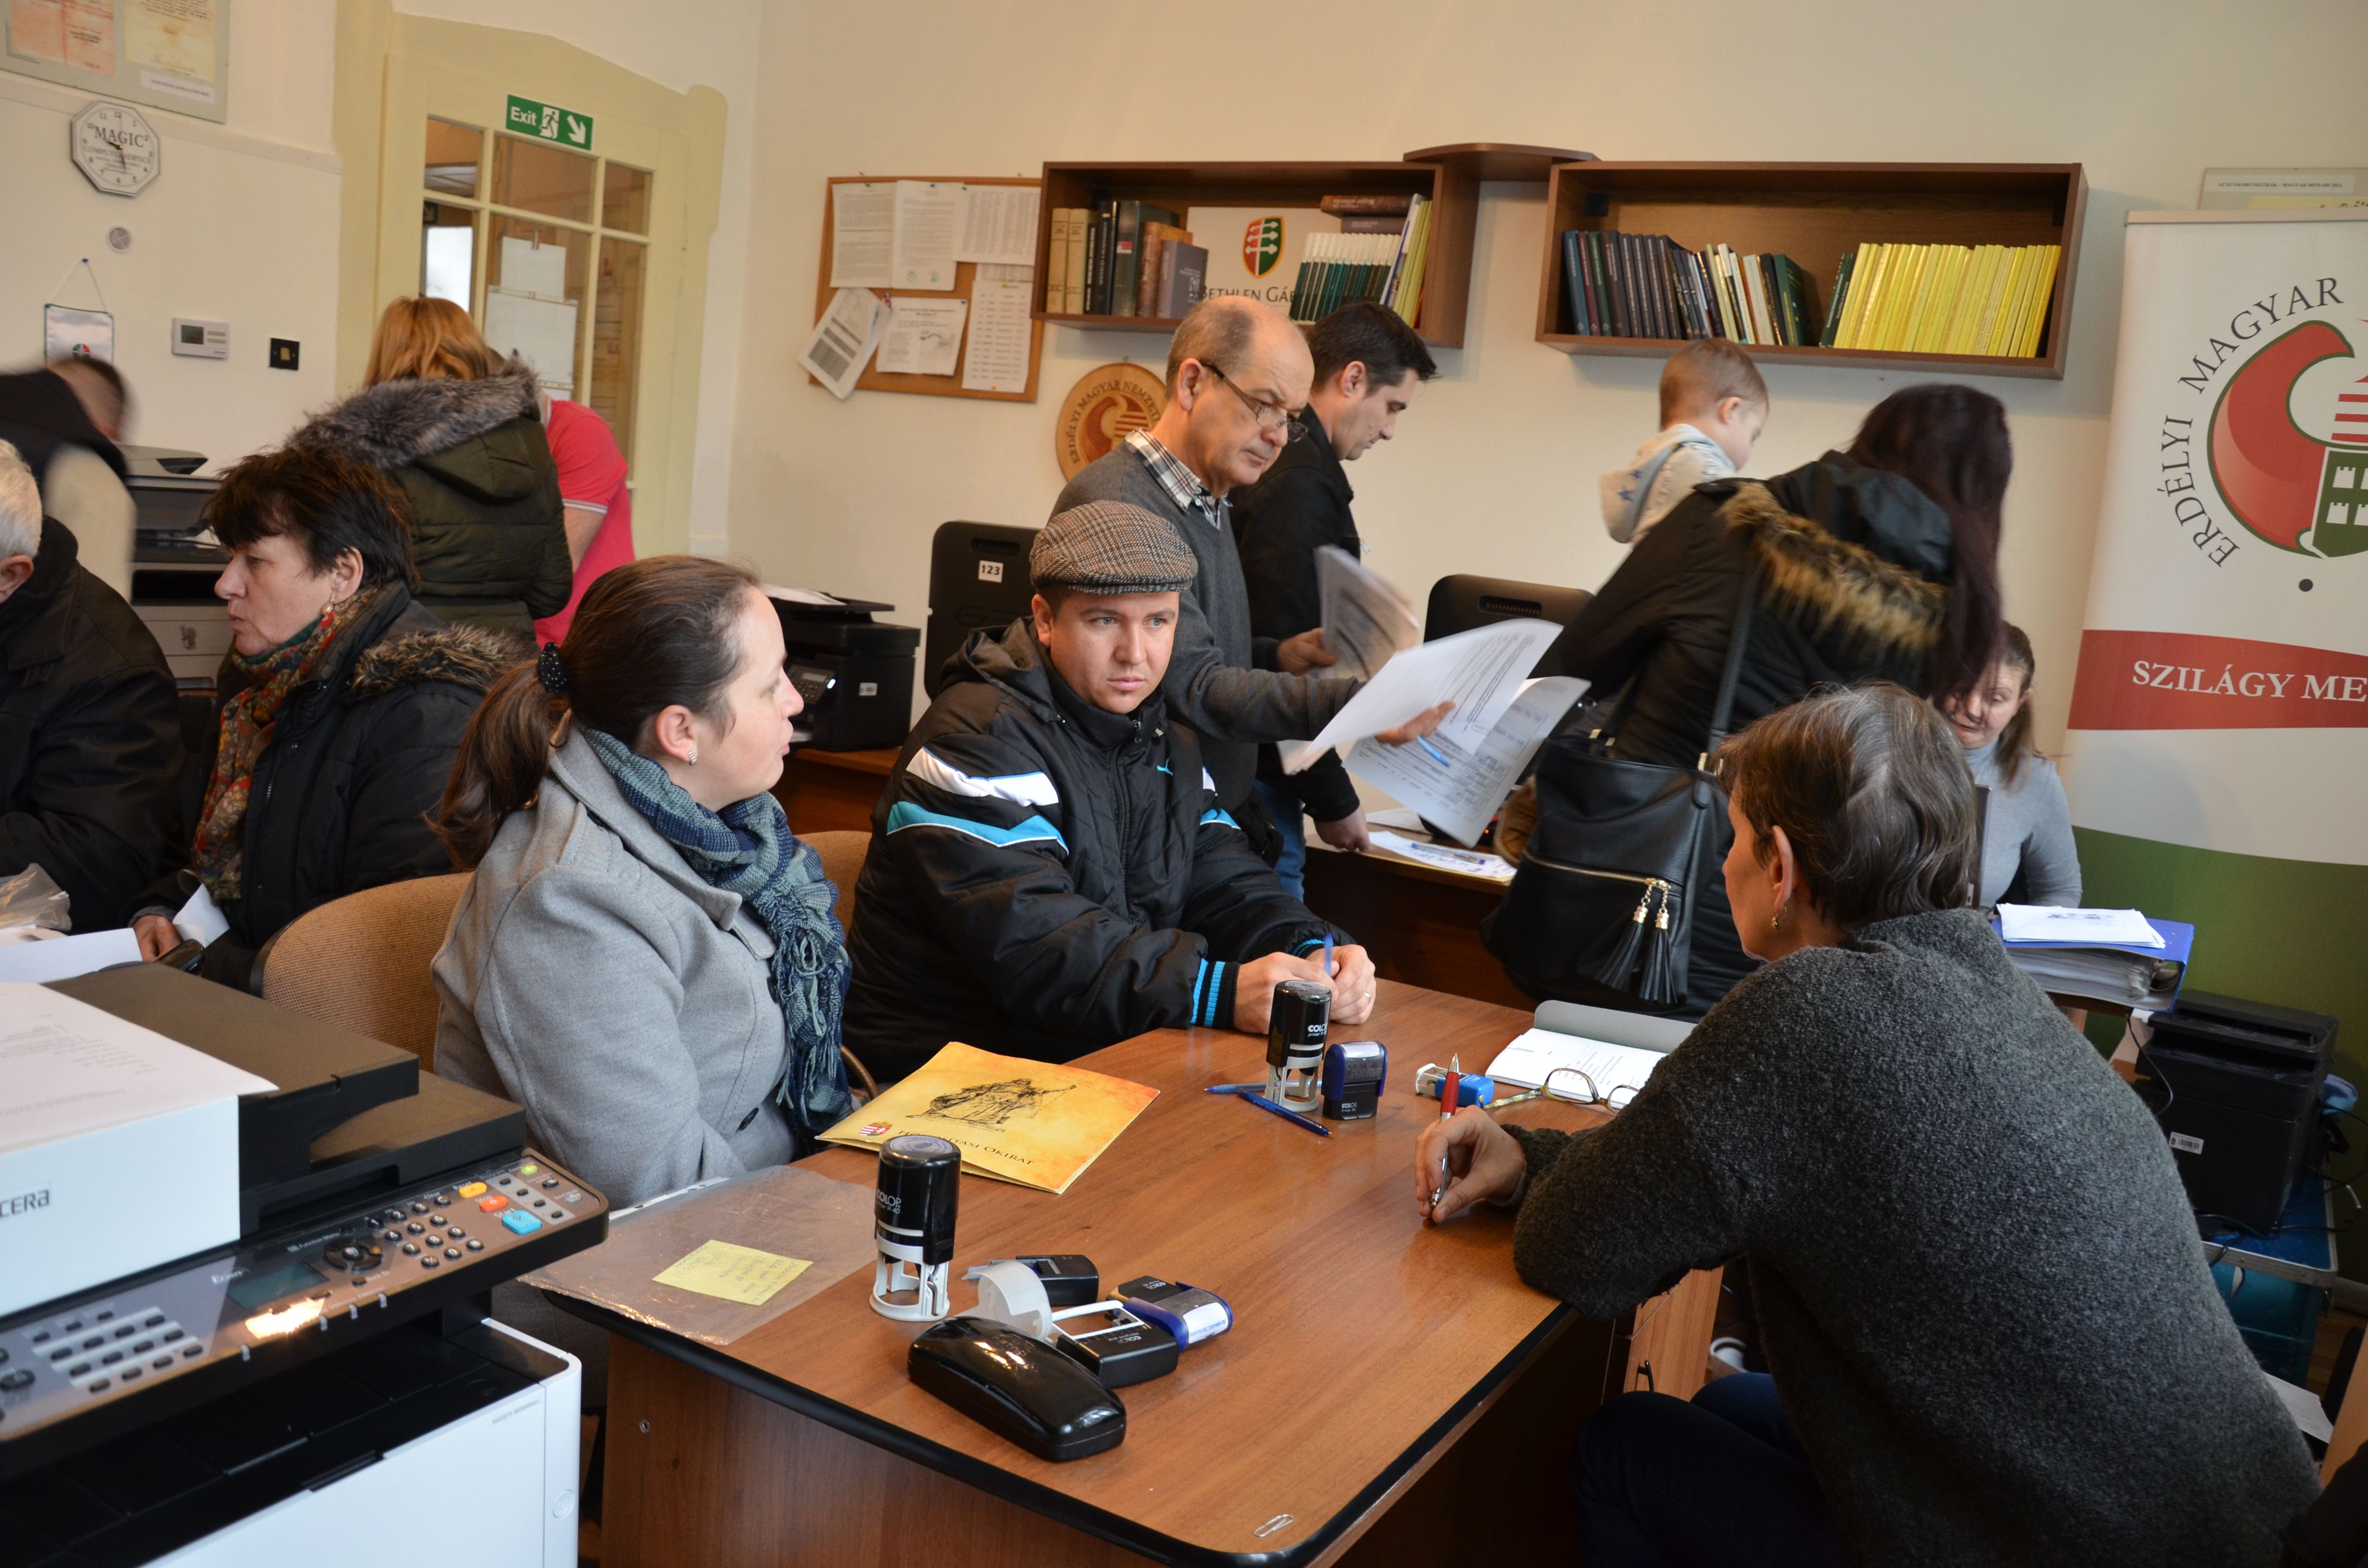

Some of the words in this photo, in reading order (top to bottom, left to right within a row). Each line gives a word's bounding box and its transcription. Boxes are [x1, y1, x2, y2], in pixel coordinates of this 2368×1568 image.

[511, 106, 537, 126] Exit
[94, 125, 144, 148] MAGIC
[2177, 277, 2344, 394] MAGYAR
[1079, 380, 1120, 410] MAGYAR
[2157, 414, 2240, 567] ERDÉLYI
[982, 564, 1000, 576] 123
[2133, 660, 2295, 698] SZILÁGY
[984, 1146, 1035, 1165] OKIRAT
[876, 1189, 902, 1207] COLOP
